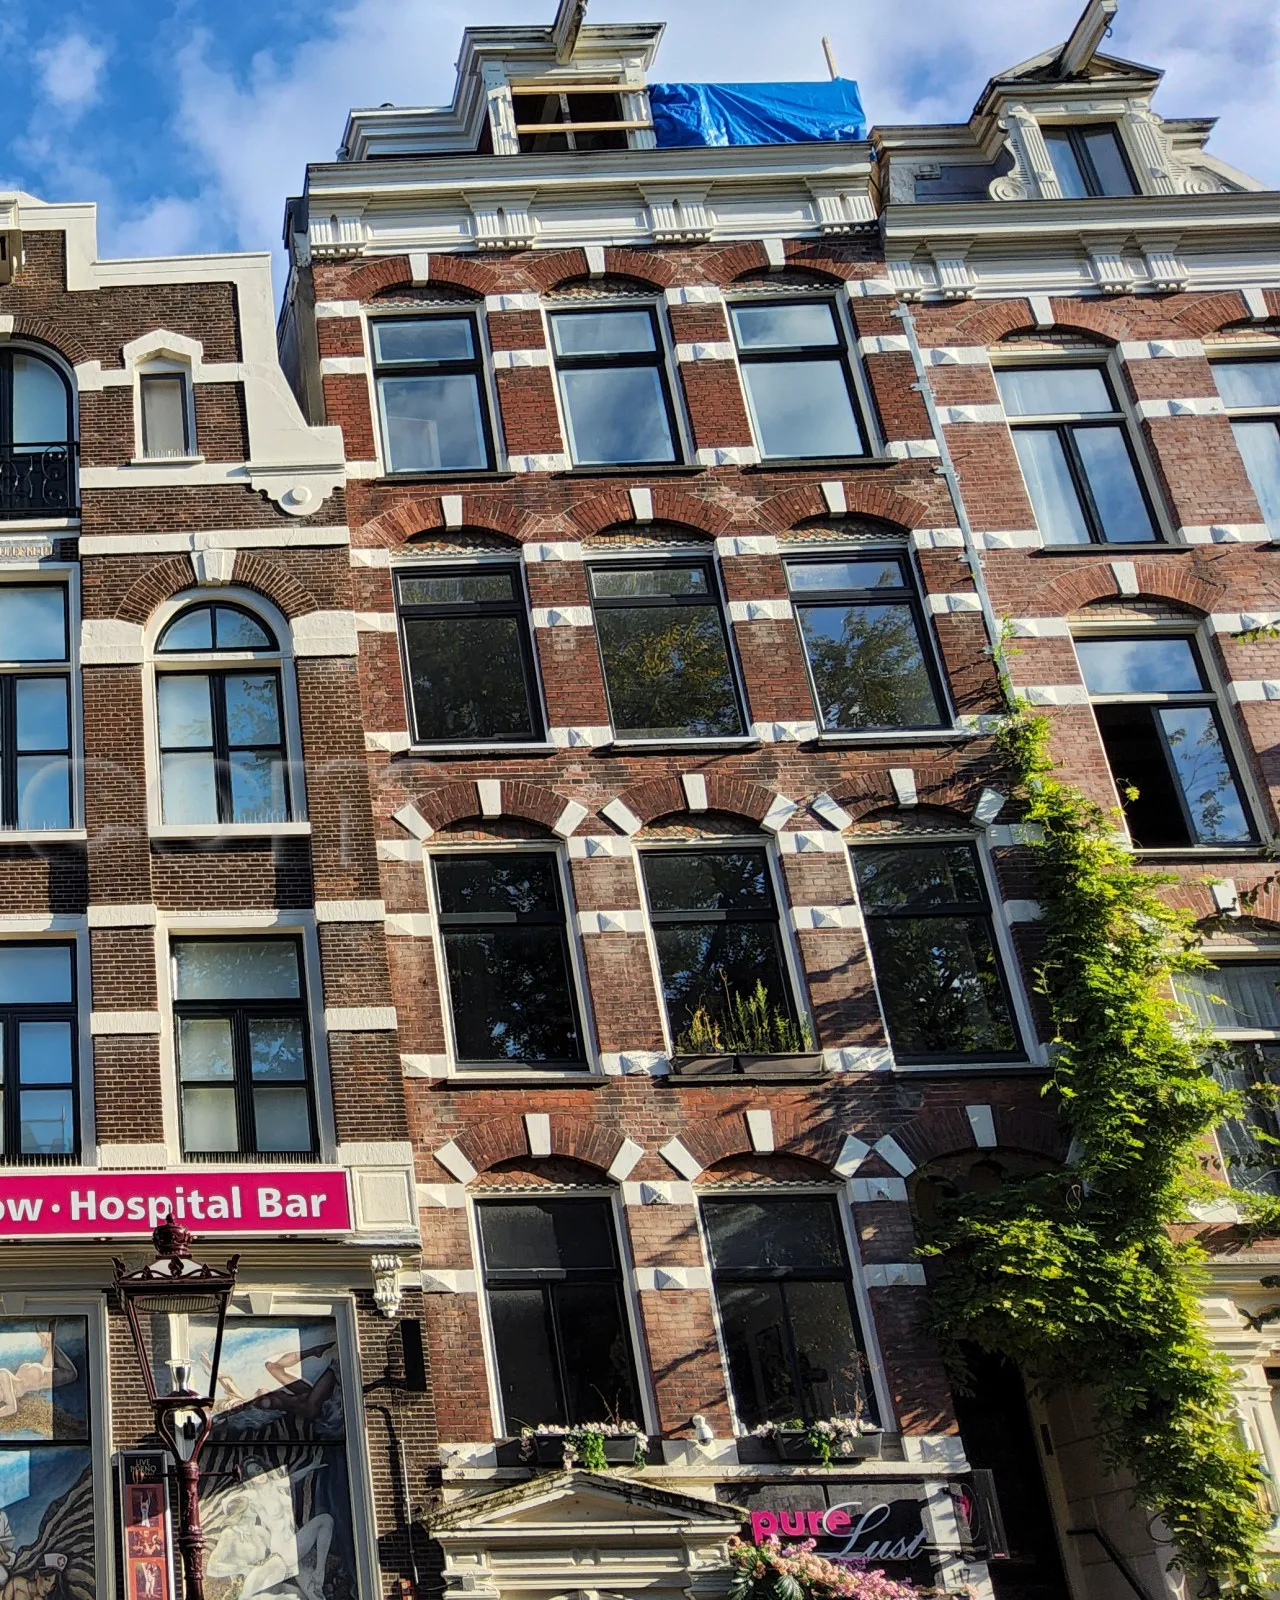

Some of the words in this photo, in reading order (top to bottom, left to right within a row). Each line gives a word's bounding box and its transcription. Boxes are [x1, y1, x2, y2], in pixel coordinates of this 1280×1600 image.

[70, 1186, 242, 1229] Hospital
[258, 1187, 327, 1219] Bar
[751, 1509, 851, 1546] pure
[820, 1501, 930, 1560] Lust
[950, 1568, 971, 1584] 117
